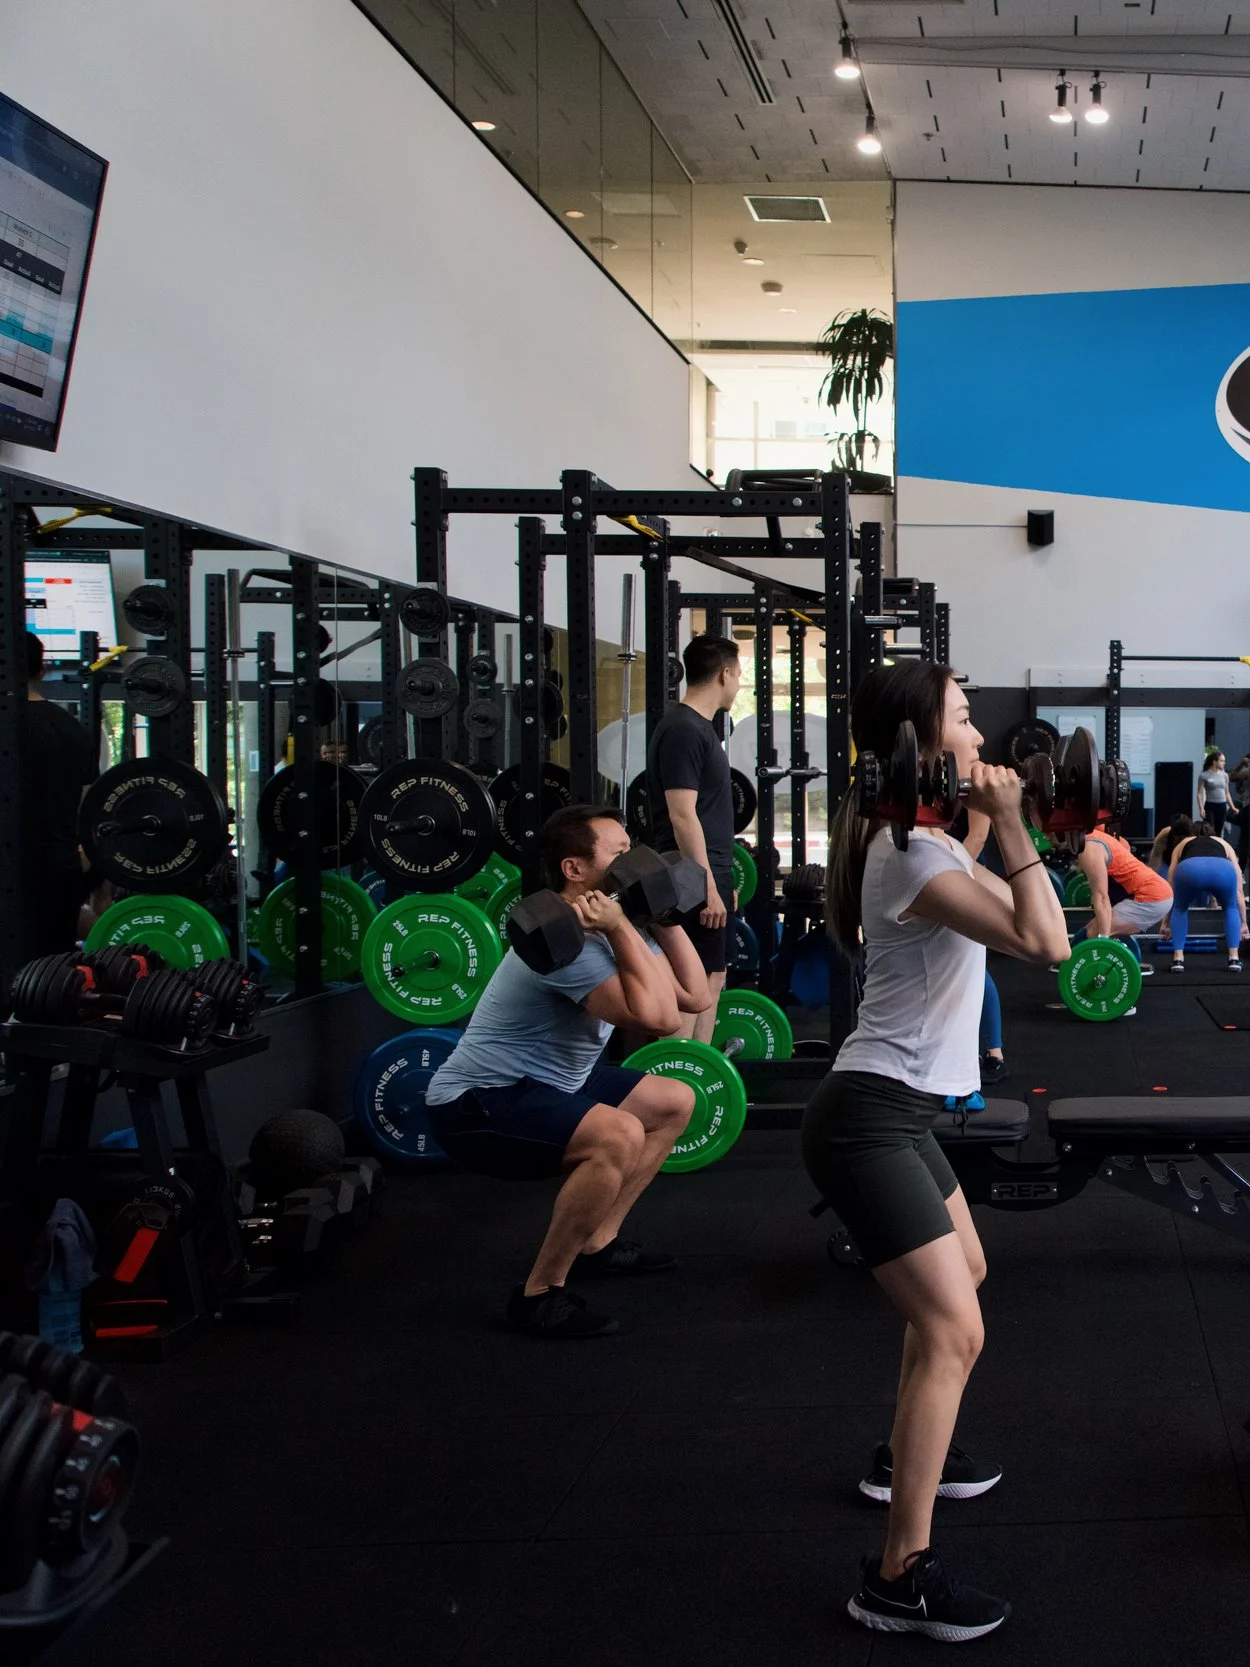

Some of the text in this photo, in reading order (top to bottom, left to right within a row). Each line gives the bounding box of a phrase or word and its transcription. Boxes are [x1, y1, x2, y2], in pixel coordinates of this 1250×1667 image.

[391, 777, 469, 813] REP FITNESS
[544, 779, 559, 788] EP
[373, 814, 388, 822] 10LB
[462, 828, 476, 837] 10LB
[381, 838, 460, 874] REP FITNESS
[392, 920, 409, 937] 25LB
[500, 914, 508, 939] REP
[418, 914, 478, 978] REP FITNESS
[382, 942, 442, 1006] REP FITNESS
[1071, 958, 1086, 994] FITNESS
[1106, 954, 1129, 1004] REP FITNESS
[451, 983, 468, 1000] 25LB
[728, 1007, 775, 1060] REP FITNESS
[421, 1049, 430, 1067] 45LB
[375, 1058, 408, 1140] REP FITNESS
[706, 1080, 724, 1095] 25LB
[708, 1105, 724, 1136] REP
[417, 1134, 426, 1152] 45LB
[998, 1184, 1051, 1198] REP
